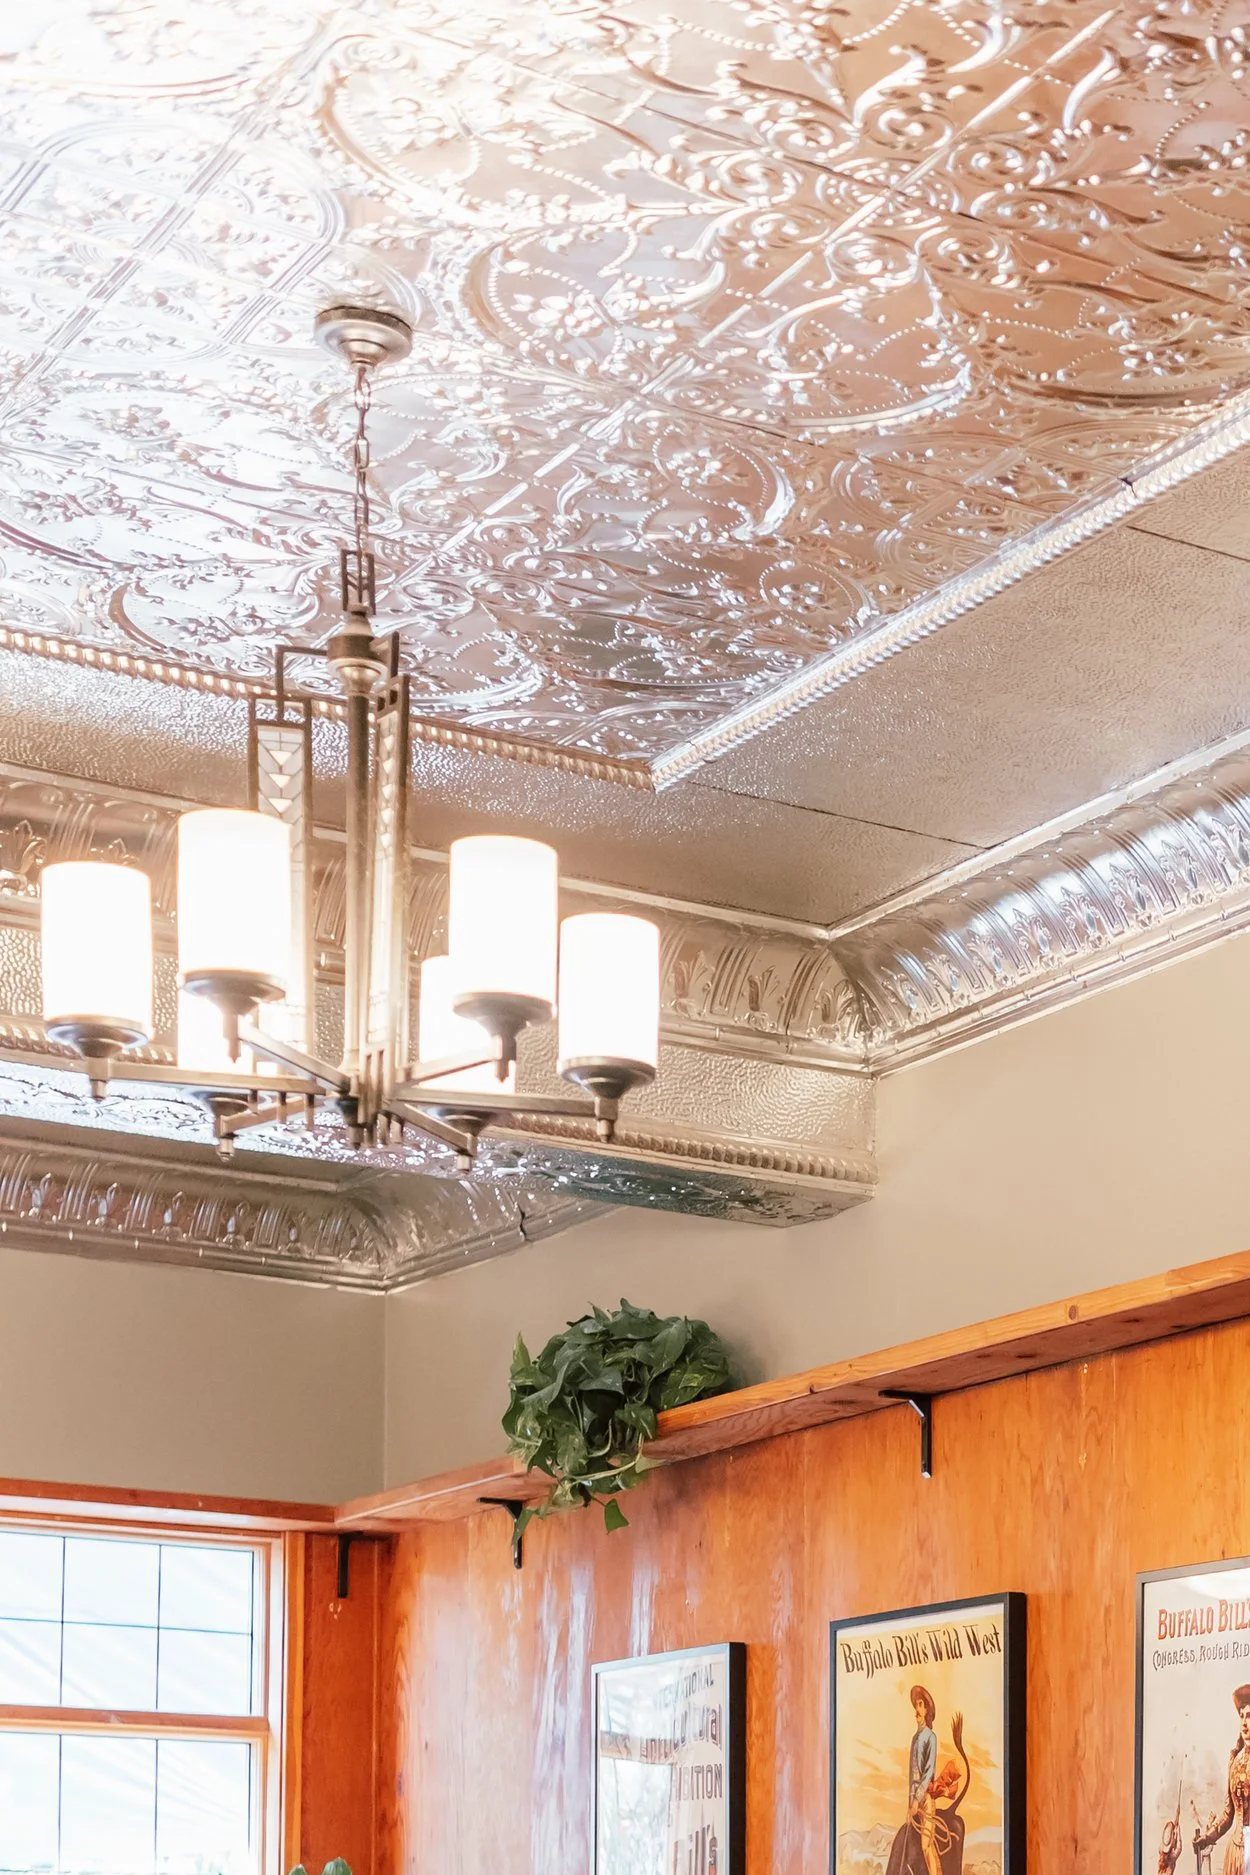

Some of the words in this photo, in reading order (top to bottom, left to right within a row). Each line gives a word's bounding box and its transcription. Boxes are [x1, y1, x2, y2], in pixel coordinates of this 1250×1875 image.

[1158, 1606, 1214, 1640] BUFFALO
[840, 1638, 894, 1680] Buffalo
[892, 1631, 929, 1668] Bill's
[926, 1627, 963, 1662] Wild
[963, 1623, 1002, 1658] West
[1199, 1641, 1229, 1663] ROUGH
